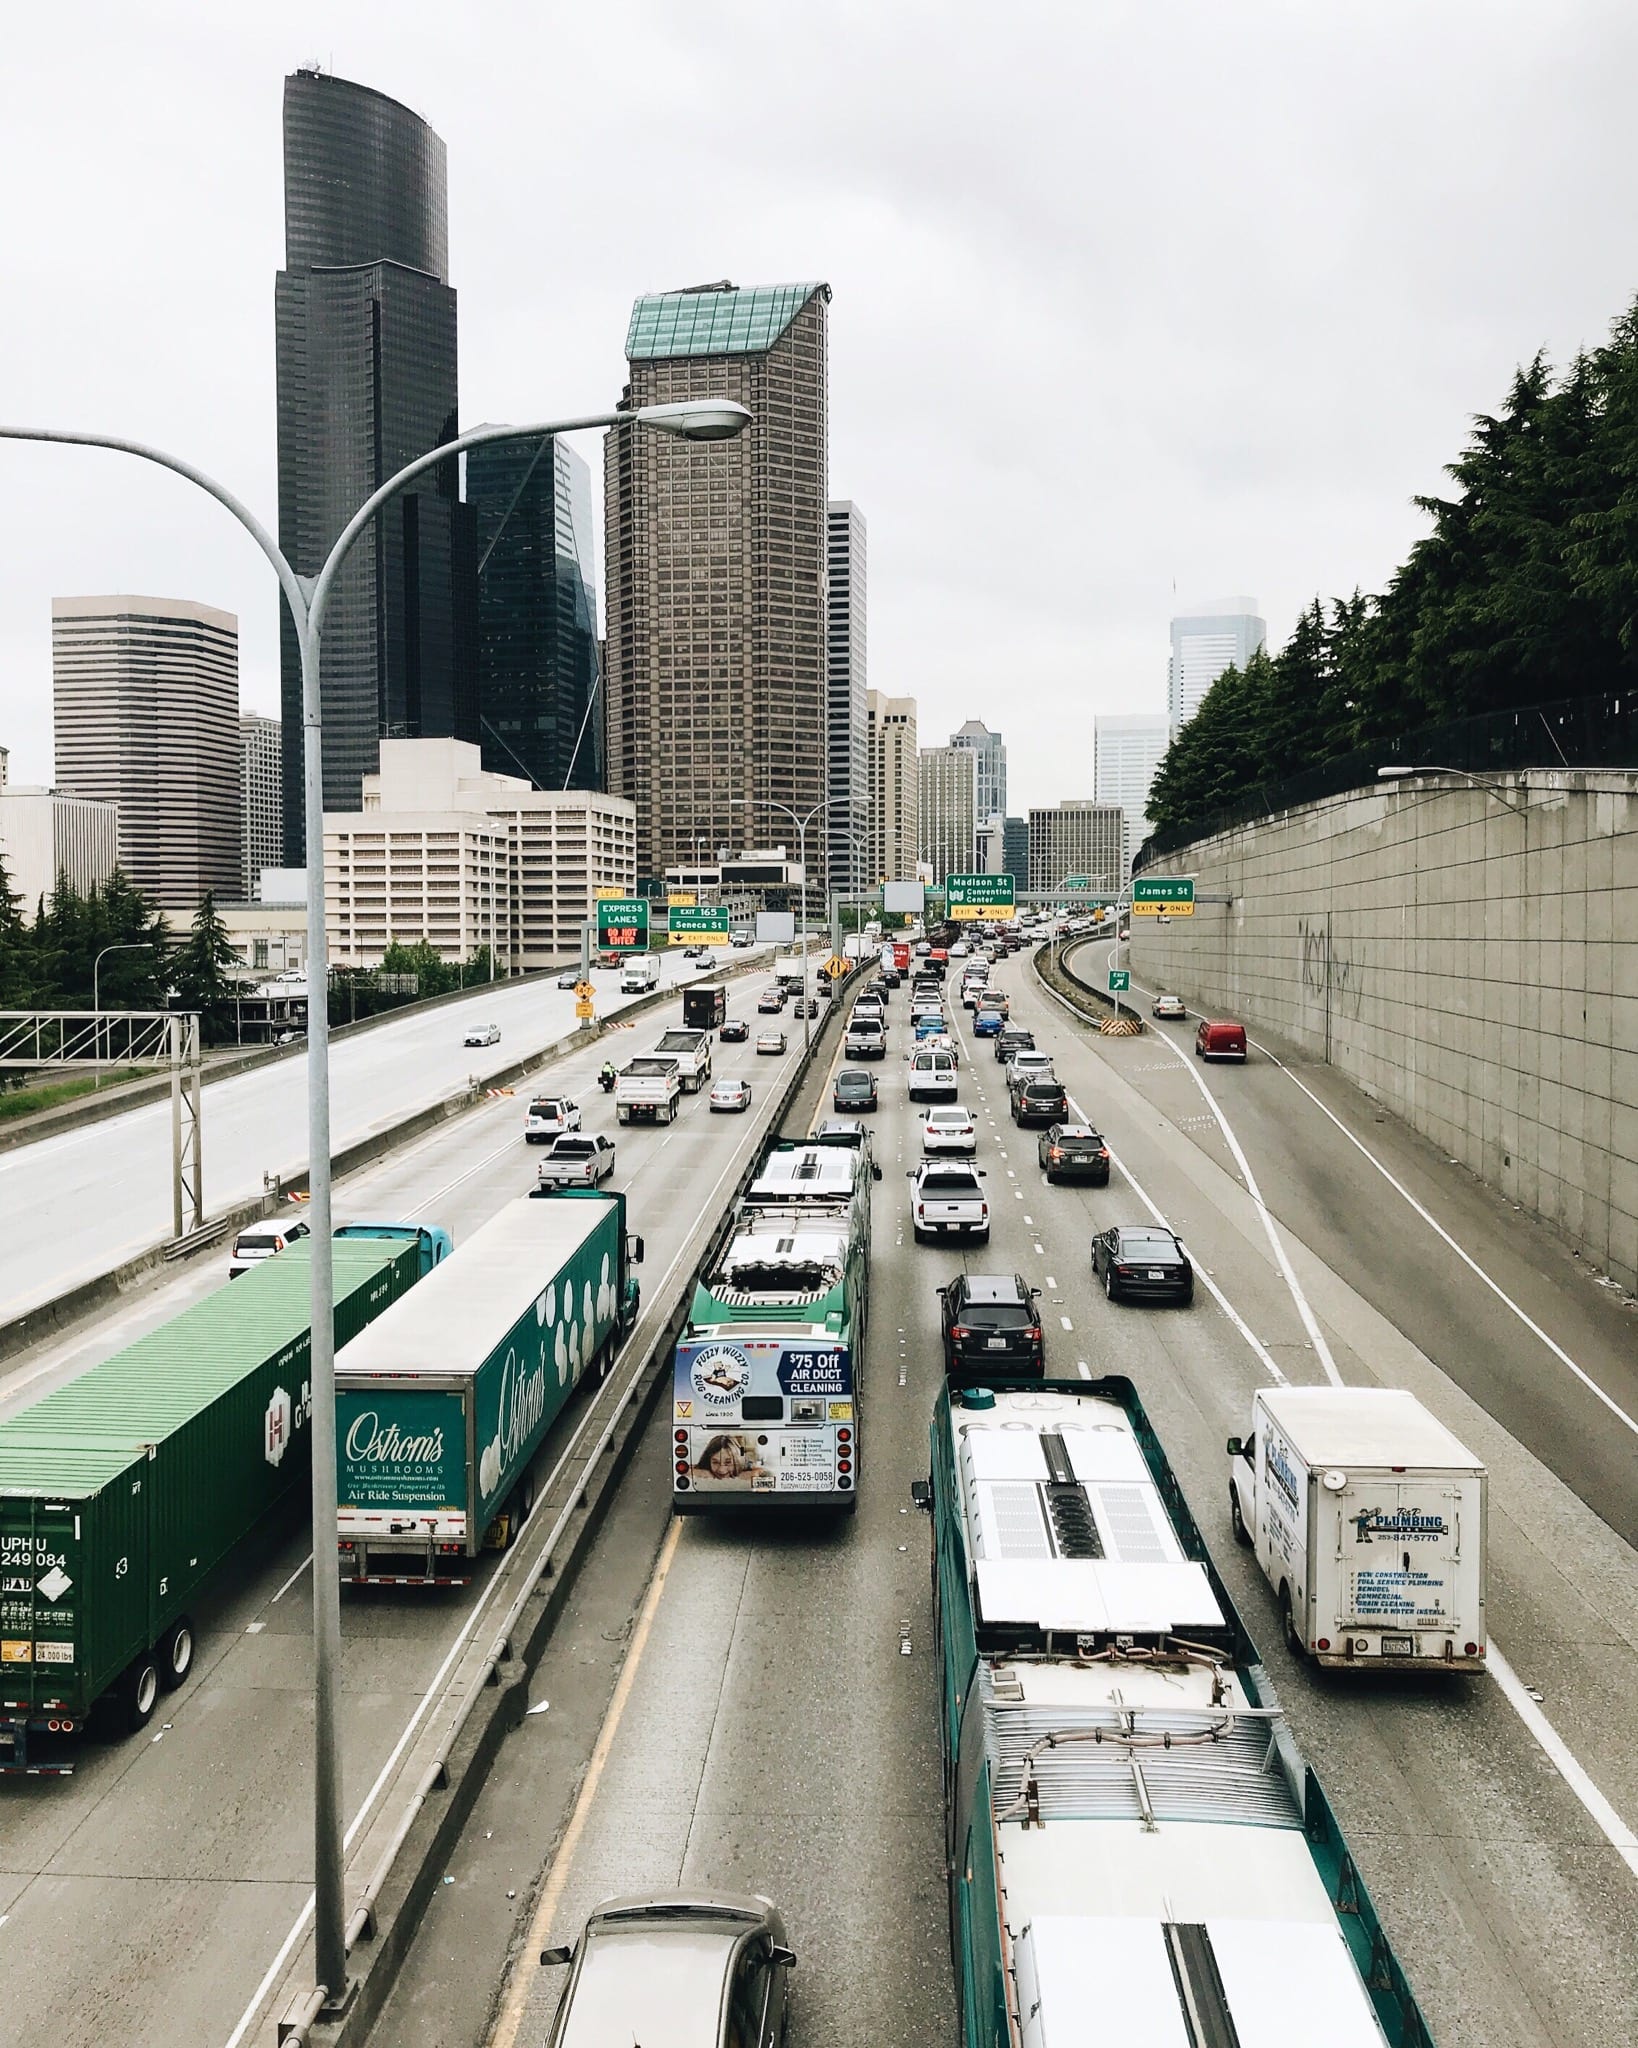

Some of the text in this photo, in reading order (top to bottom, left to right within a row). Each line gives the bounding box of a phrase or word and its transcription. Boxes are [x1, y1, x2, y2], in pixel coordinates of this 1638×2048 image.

[997, 878, 1008, 886] St
[1177, 887, 1188, 895] St
[608, 928, 638, 937] DO NOT
[610, 937, 636, 945] ENTER
[696, 1346, 748, 1367] FUZZY WUZZY
[790, 1353, 839, 1368] $75 Off
[791, 1369, 842, 1380] AIR DUCT
[694, 1374, 706, 1392] RUG
[704, 1386, 745, 1405] CLEANING
[790, 1383, 843, 1392] CLEANING
[346, 1411, 444, 1462] Ostrom's
[346, 1465, 443, 1474] MUSHROOMS
[780, 1472, 833, 1481] 206-525-0058
[348, 1490, 445, 1503] Air Ride Suspension
[1375, 1516, 1442, 1526] PLUMBING
